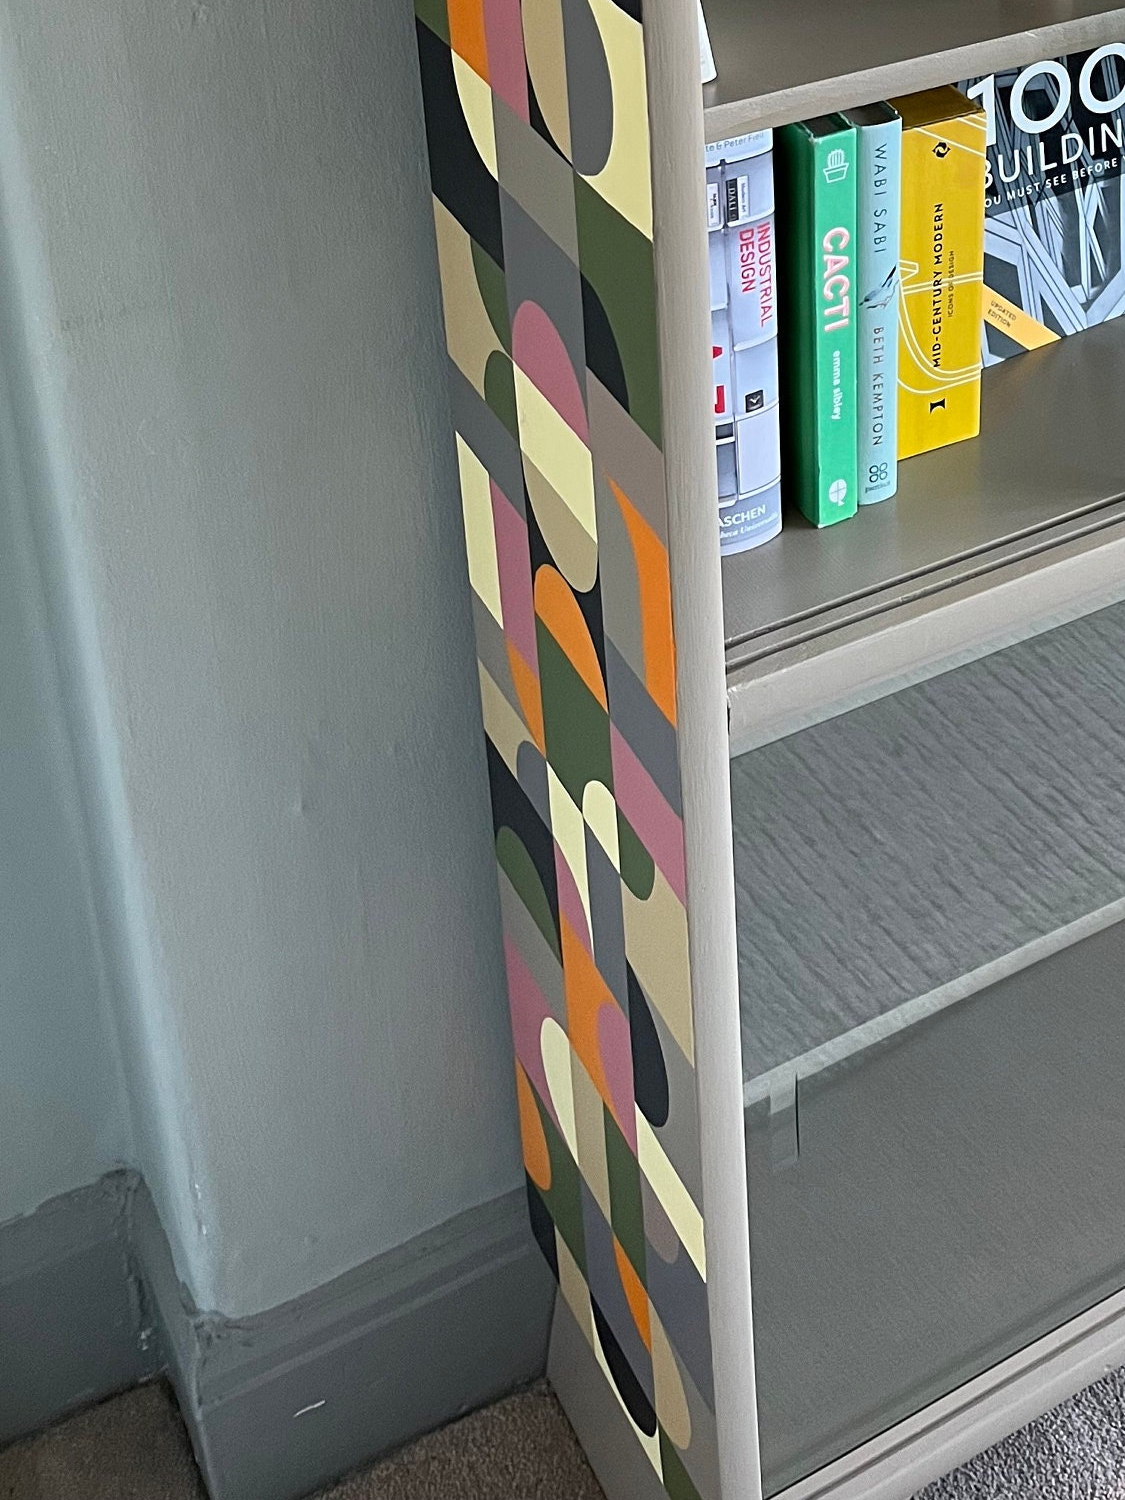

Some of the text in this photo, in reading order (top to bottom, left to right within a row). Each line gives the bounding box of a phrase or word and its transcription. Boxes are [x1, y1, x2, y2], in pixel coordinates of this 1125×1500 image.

[724, 138, 746, 149] Peter
[873, 143, 888, 253] WABI SABI
[984, 195, 1001, 208] OU
[1006, 183, 1040, 200] MUST
[1045, 173, 1067, 189] SEE
[1072, 157, 1118, 180] BEFORE
[739, 228, 756, 293] DESIGN
[757, 222, 773, 327] INDUSTRIAL
[822, 226, 850, 332] CACTI
[932, 203, 944, 368] MID-CENTURY MODERN
[987, 309, 1011, 328] EDITION
[991, 300, 1017, 321] UPDATED
[830, 350, 842, 421] emma sibley
[872, 327, 884, 446] BETH KEMPTON
[719, 504, 766, 528] ASCHEN
